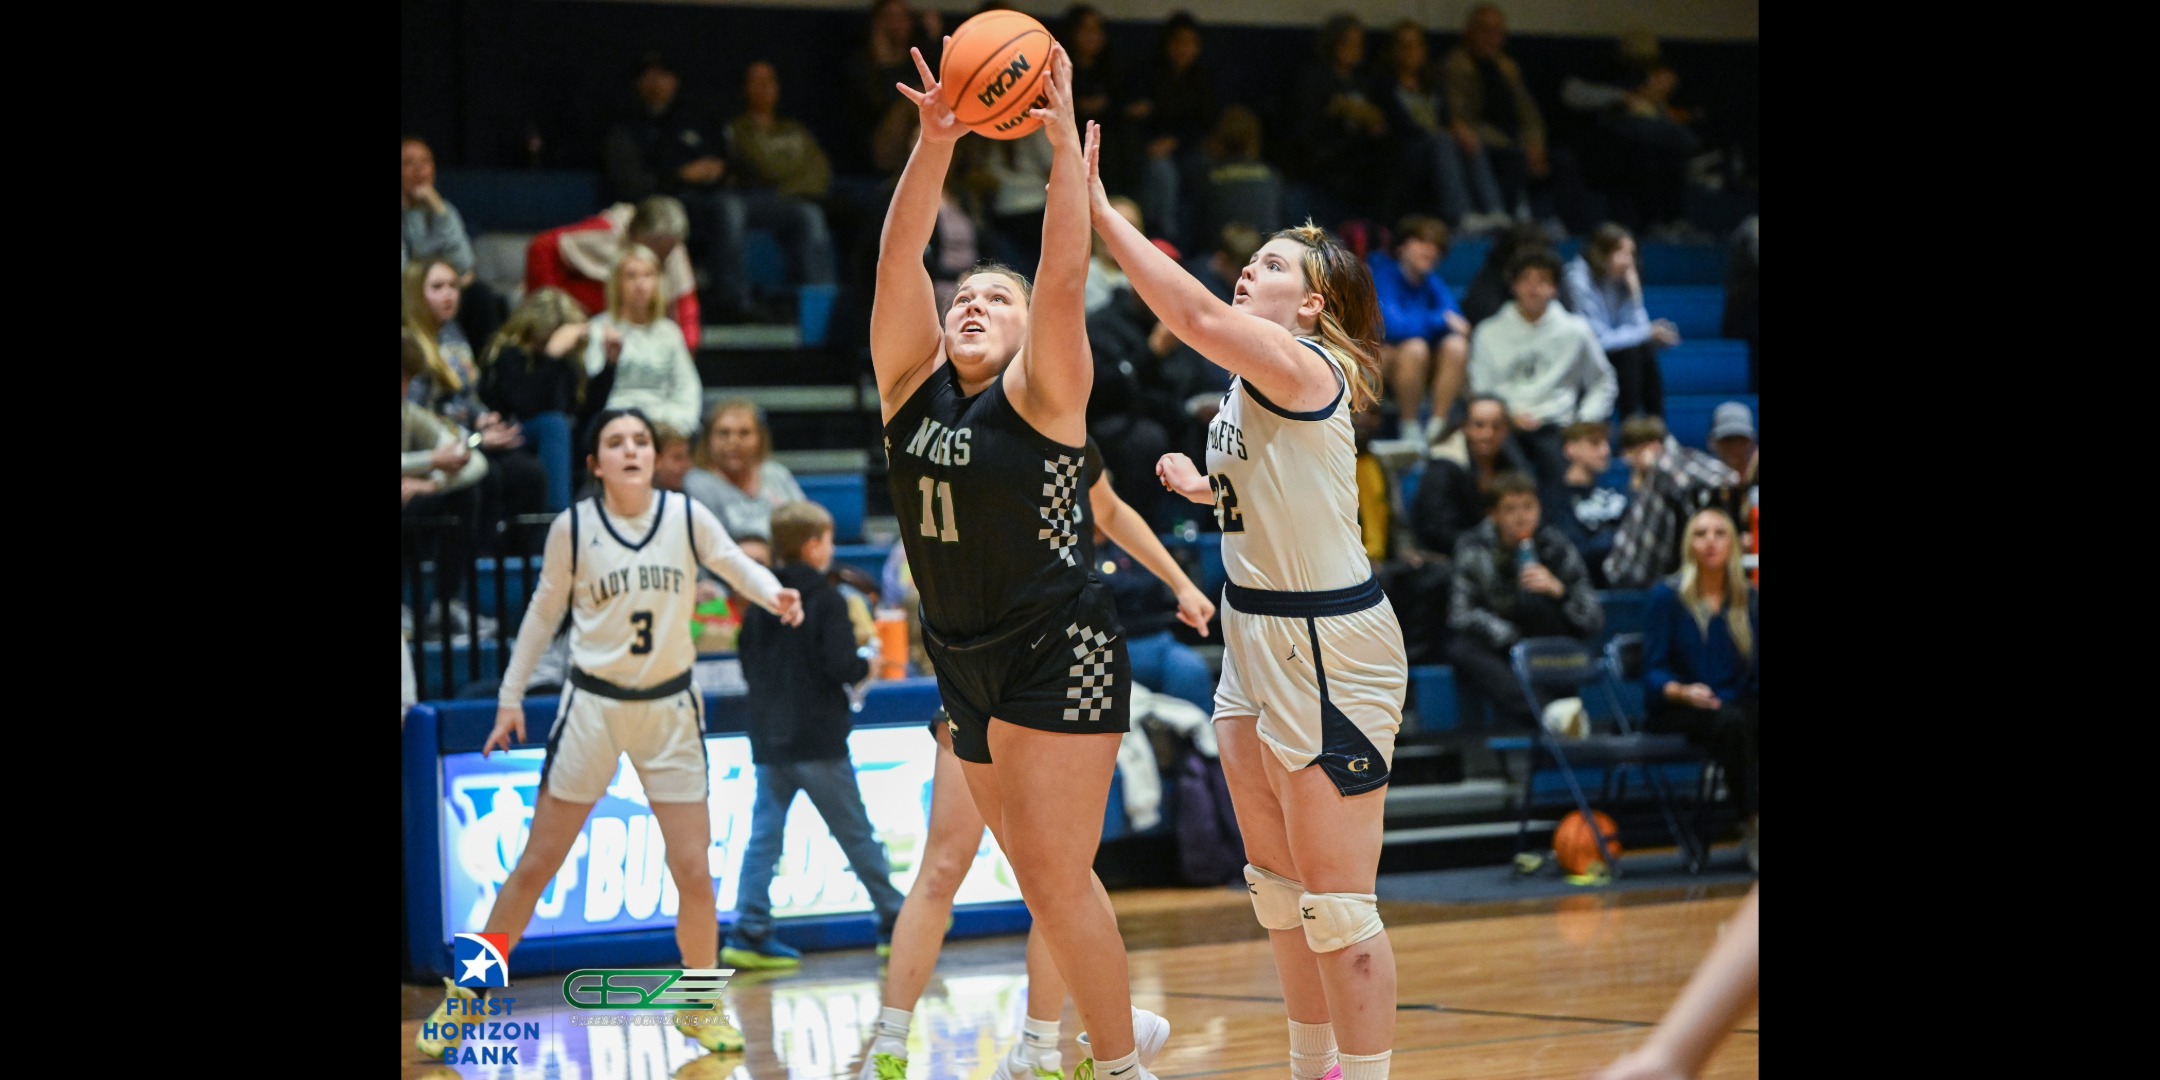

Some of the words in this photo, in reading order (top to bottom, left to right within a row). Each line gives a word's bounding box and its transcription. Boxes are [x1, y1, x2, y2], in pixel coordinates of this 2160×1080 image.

[977, 53, 1031, 109] NCAA
[919, 475, 960, 543] 11
[590, 567, 629, 606] LADY
[629, 609, 654, 656] 3
